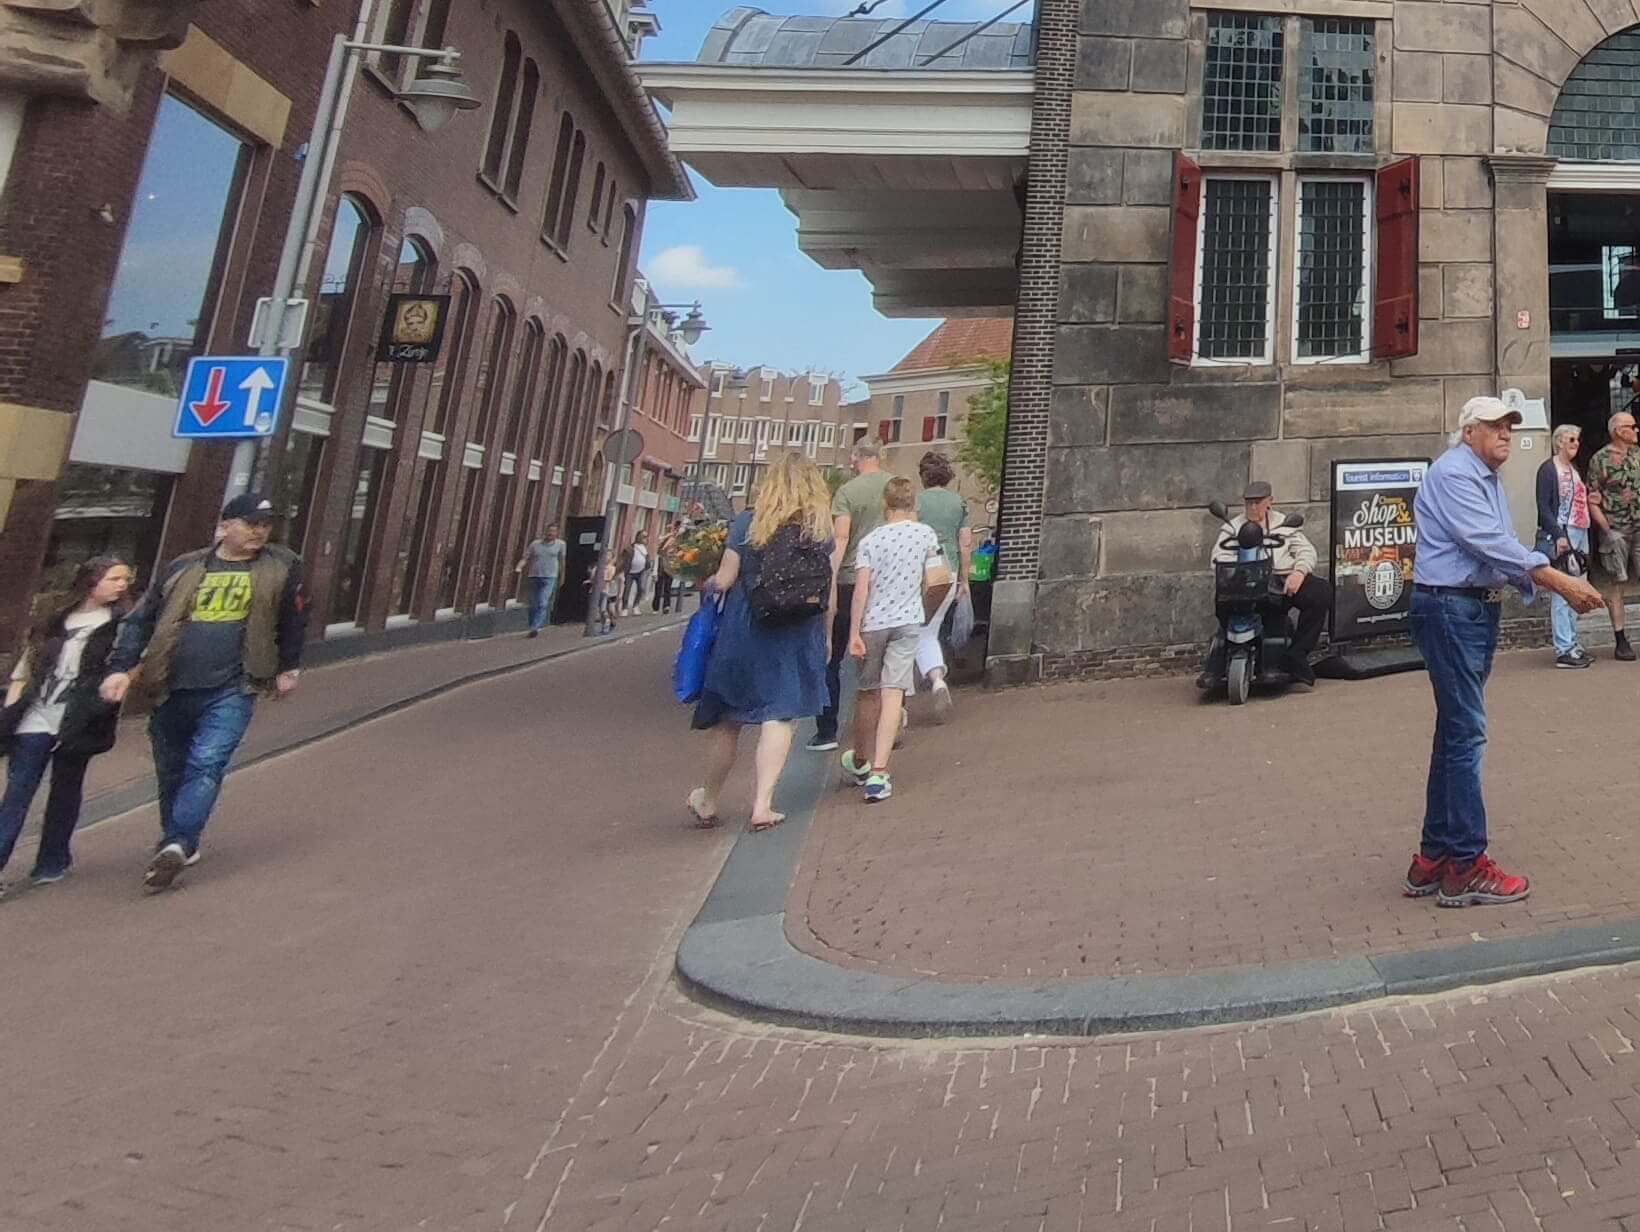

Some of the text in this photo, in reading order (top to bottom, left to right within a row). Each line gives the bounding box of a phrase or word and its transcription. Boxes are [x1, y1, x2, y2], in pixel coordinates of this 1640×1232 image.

[1345, 472, 1409, 482] Tourist information
[1353, 493, 1411, 528] Shop &
[1344, 526, 1417, 549] MUSEUM
